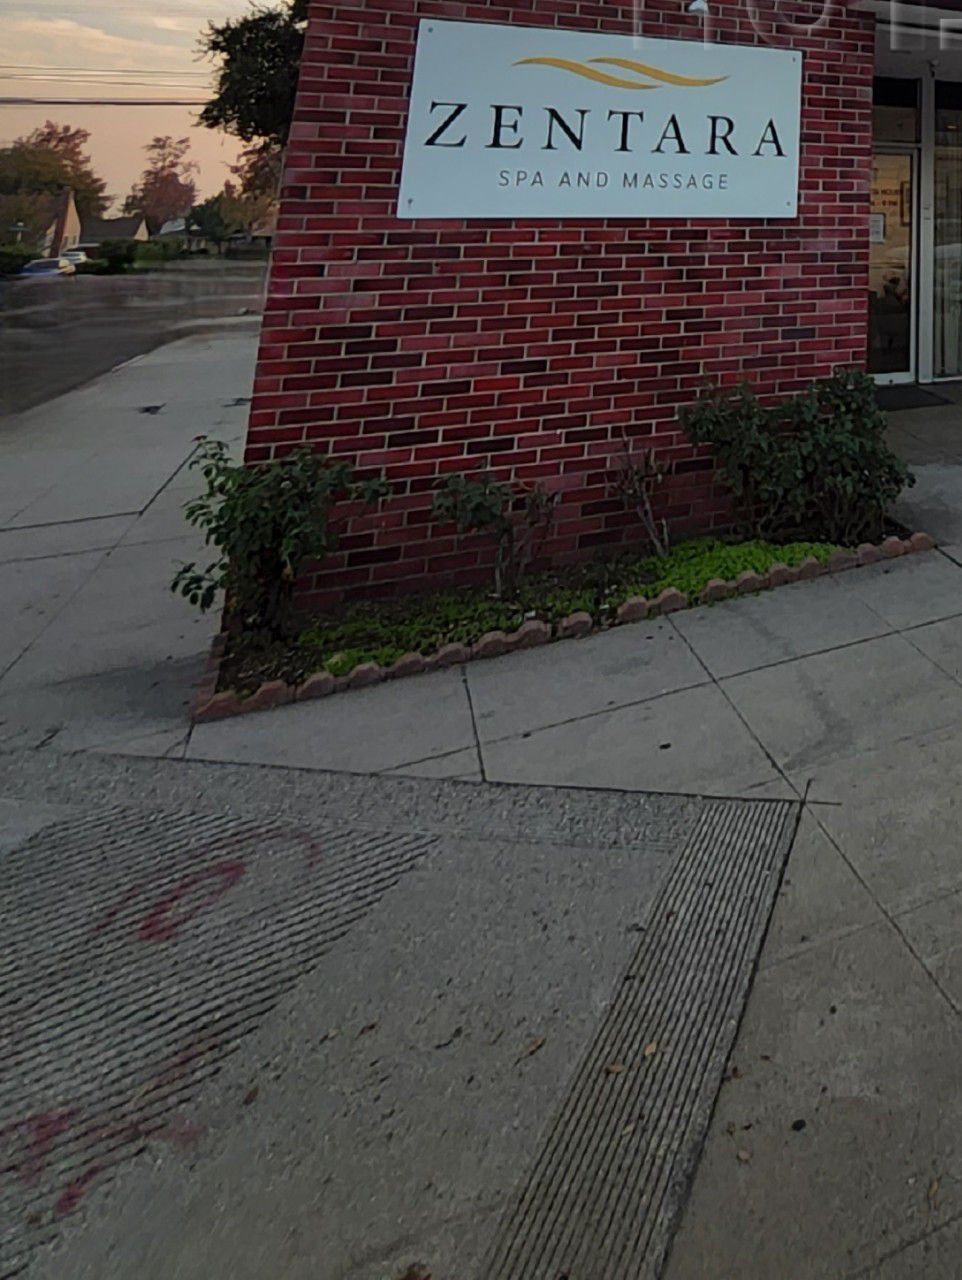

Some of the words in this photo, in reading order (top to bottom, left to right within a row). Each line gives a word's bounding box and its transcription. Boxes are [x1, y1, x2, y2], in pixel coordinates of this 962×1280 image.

[423, 101, 788, 158] ZENTARA
[498, 170, 544, 187] SPA
[558, 171, 609, 188] AND
[623, 172, 729, 190] MASSAGE
